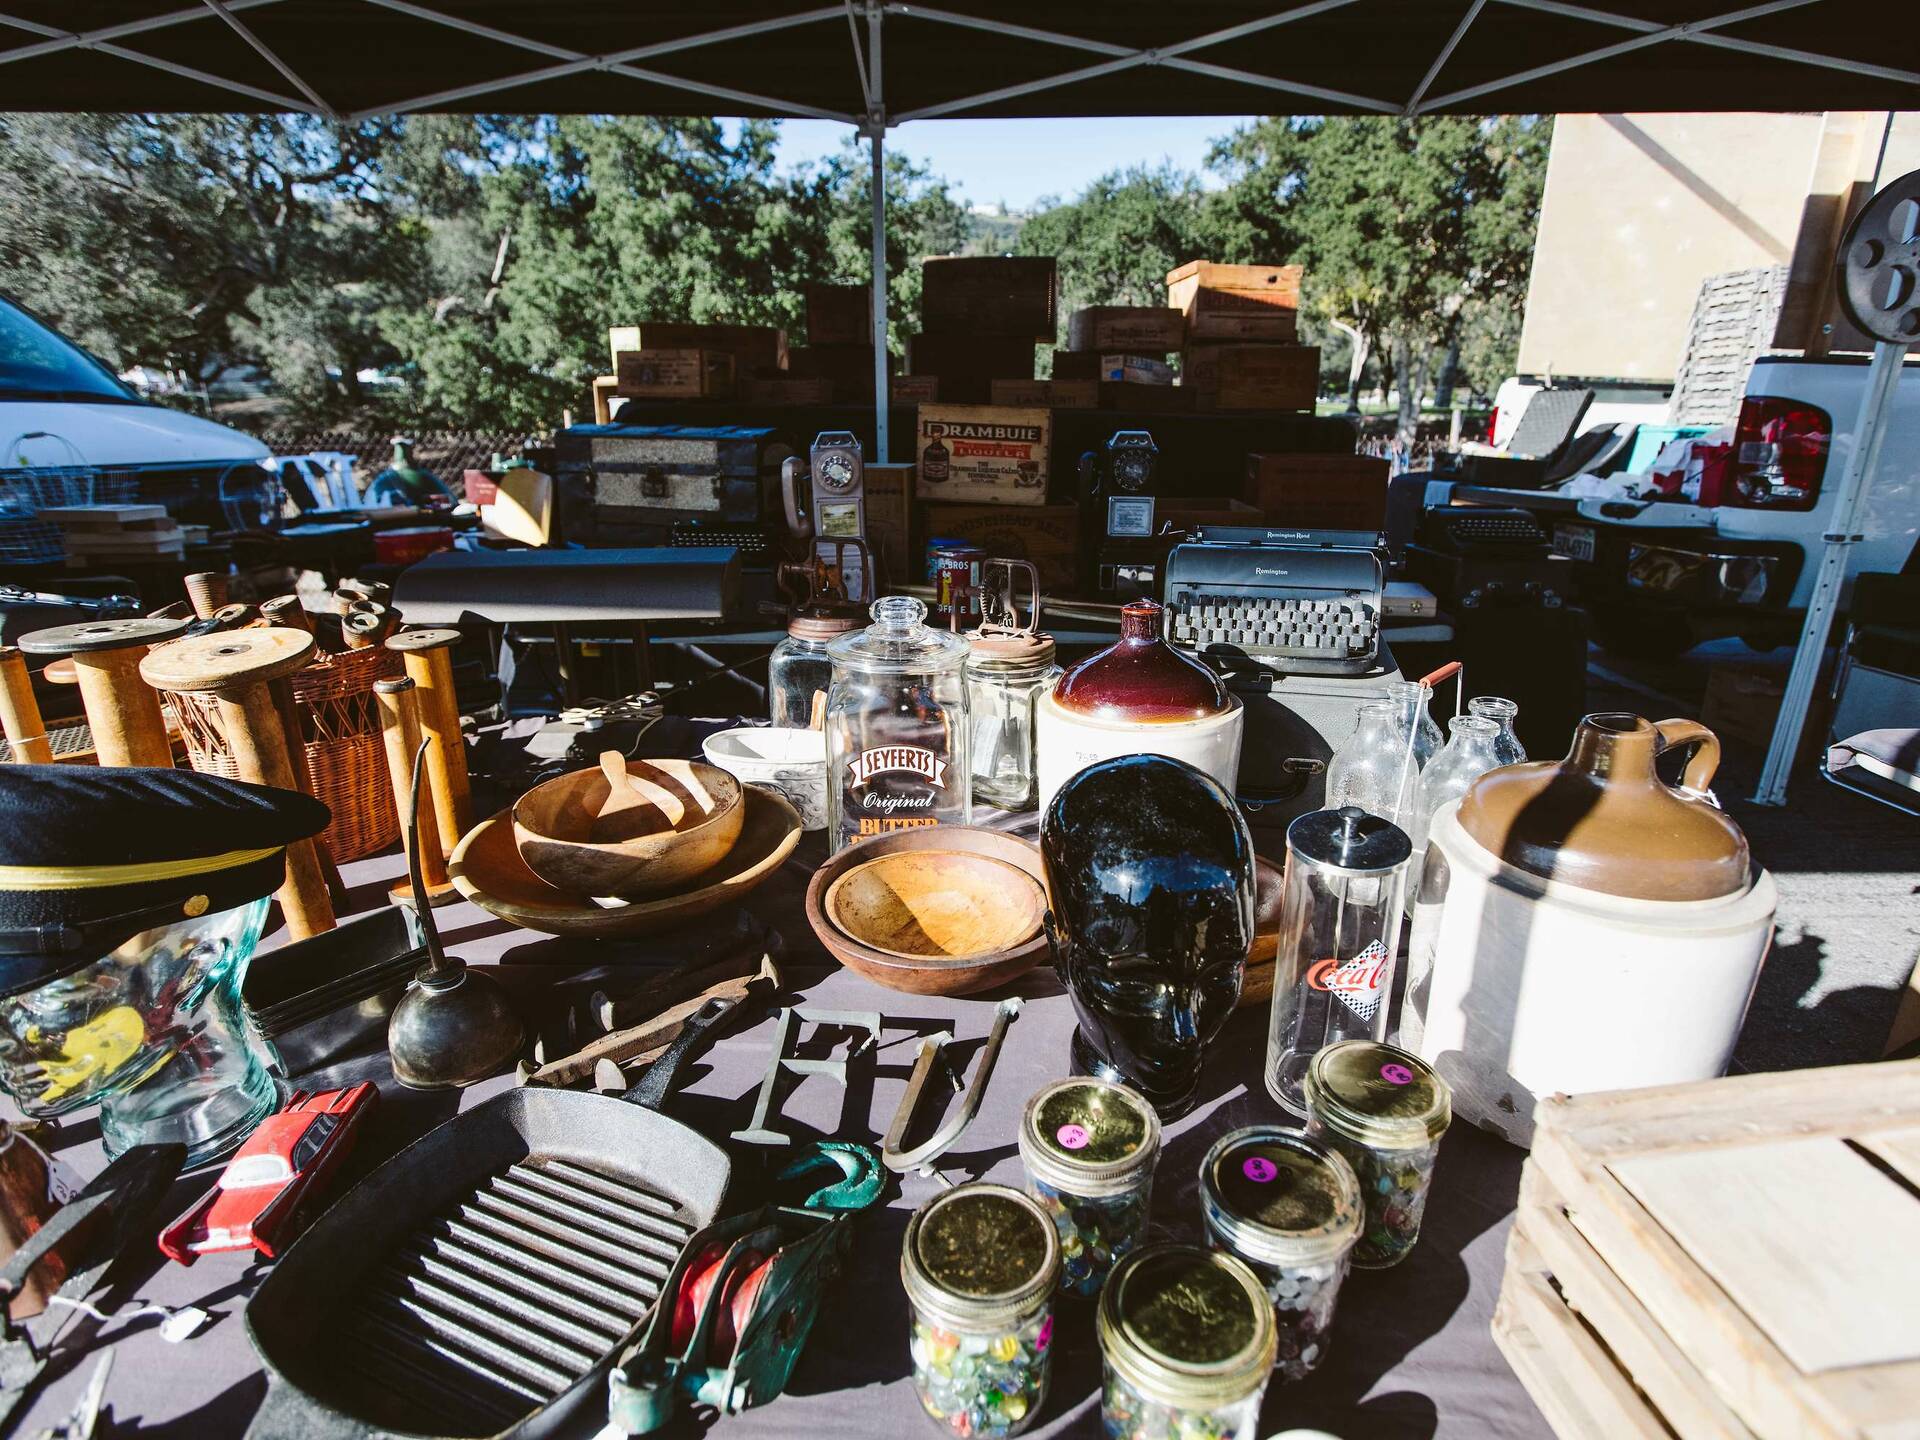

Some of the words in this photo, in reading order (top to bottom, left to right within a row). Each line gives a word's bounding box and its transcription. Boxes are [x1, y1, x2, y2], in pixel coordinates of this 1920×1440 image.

[926, 422, 1039, 440] DRAMBUIE
[1267, 531, 1296, 539] Remington
[949, 560, 969, 570] BROS
[1255, 567, 1289, 576] Remington
[866, 748, 931, 773] SEYFERT'S
[862, 791, 937, 815] Original
